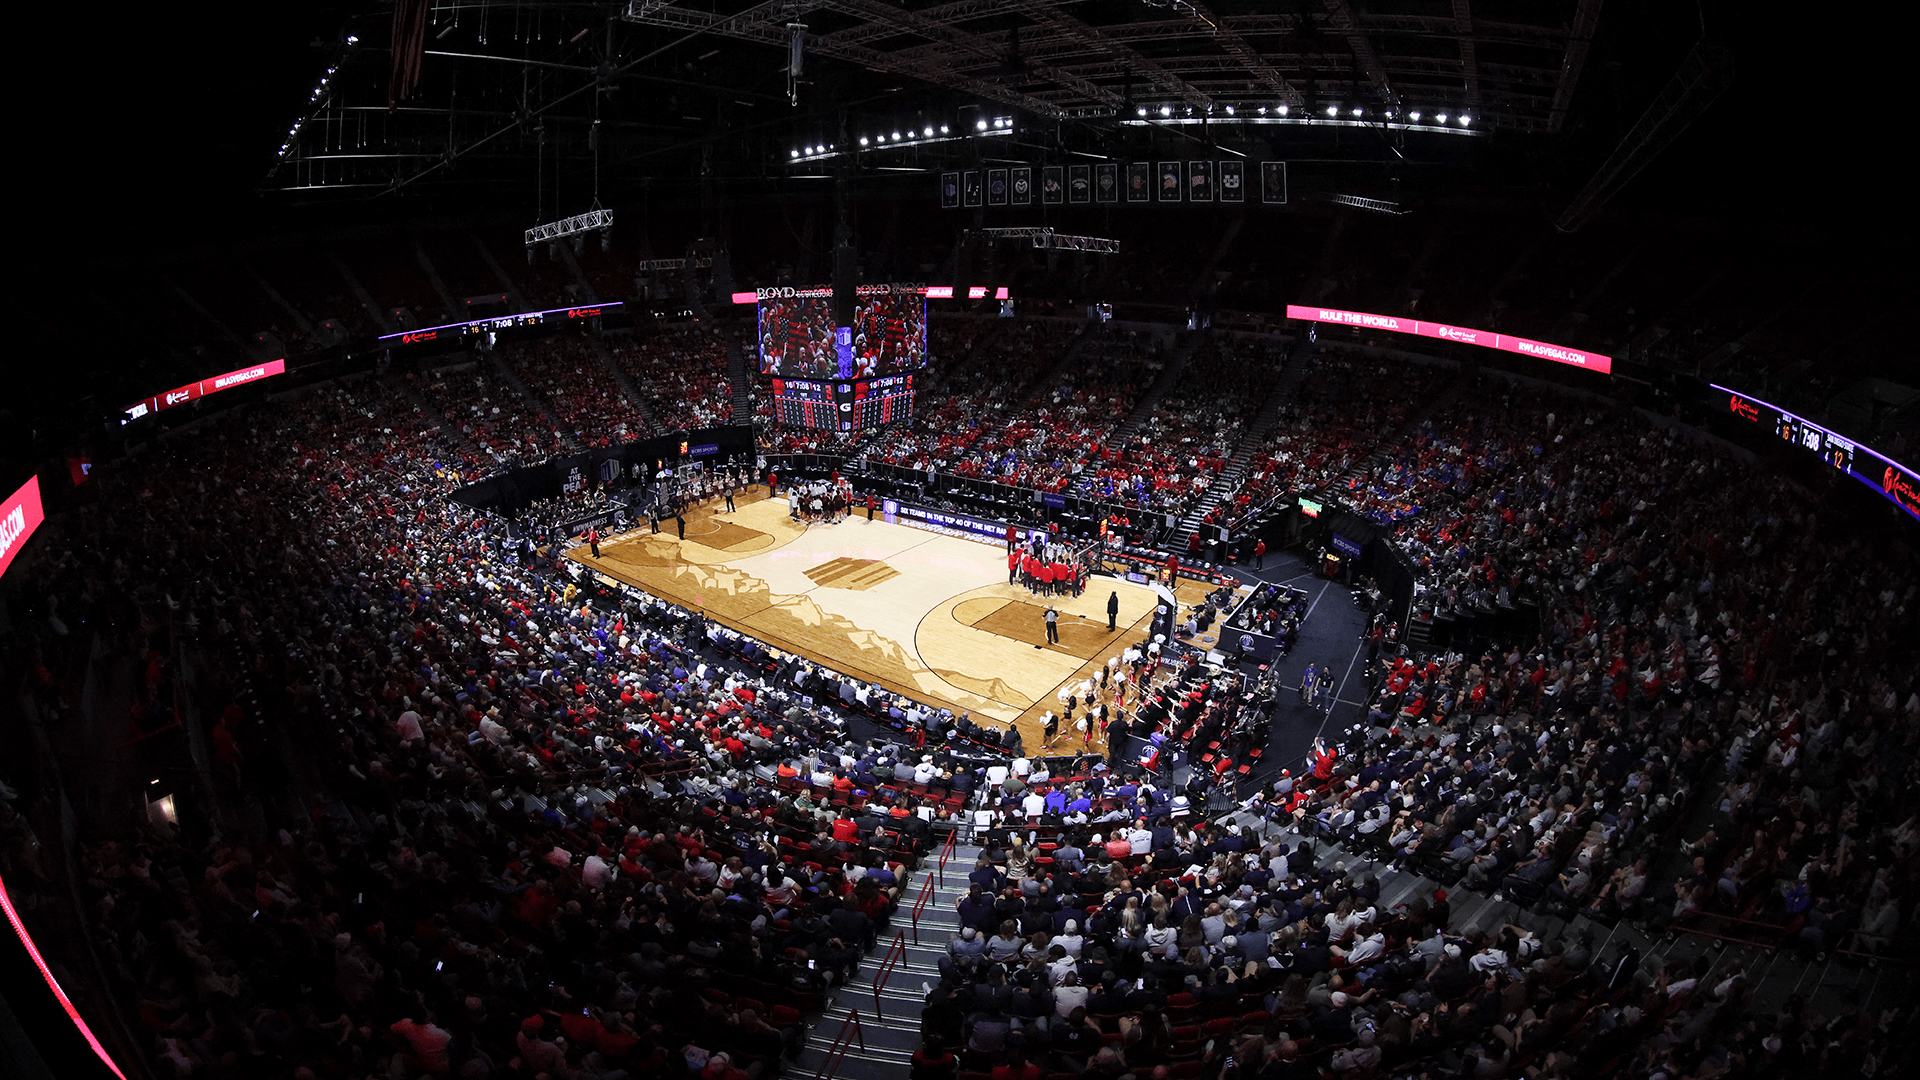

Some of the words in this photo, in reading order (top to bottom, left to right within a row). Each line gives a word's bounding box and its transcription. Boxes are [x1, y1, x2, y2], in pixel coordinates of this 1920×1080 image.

[757, 287, 796, 300] BOYD
[495, 319, 512, 328] 7:08
[1319, 310, 1343, 321] RULE
[1343, 313, 1362, 324] THE
[1362, 315, 1399, 329] WORLD.
[1518, 341, 1585, 364] RWLASVEGAS.COM
[1783, 425, 1789, 440] 16
[1803, 428, 1820, 451] 7:08
[1834, 451, 1844, 469] 12
[570, 466, 579, 475] AT
[568, 473, 582, 483] THE
[563, 481, 582, 494] PEA
[900, 506, 909, 514] SIX
[909, 509, 926, 518] TEAMS
[926, 512, 933, 520] IN
[933, 513, 944, 522] THE
[944, 516, 955, 524] TOP
[963, 520, 972, 528] OF
[972, 522, 983, 530] THE
[984, 525, 995, 533] NET
[1338, 746, 1346, 756] 15
